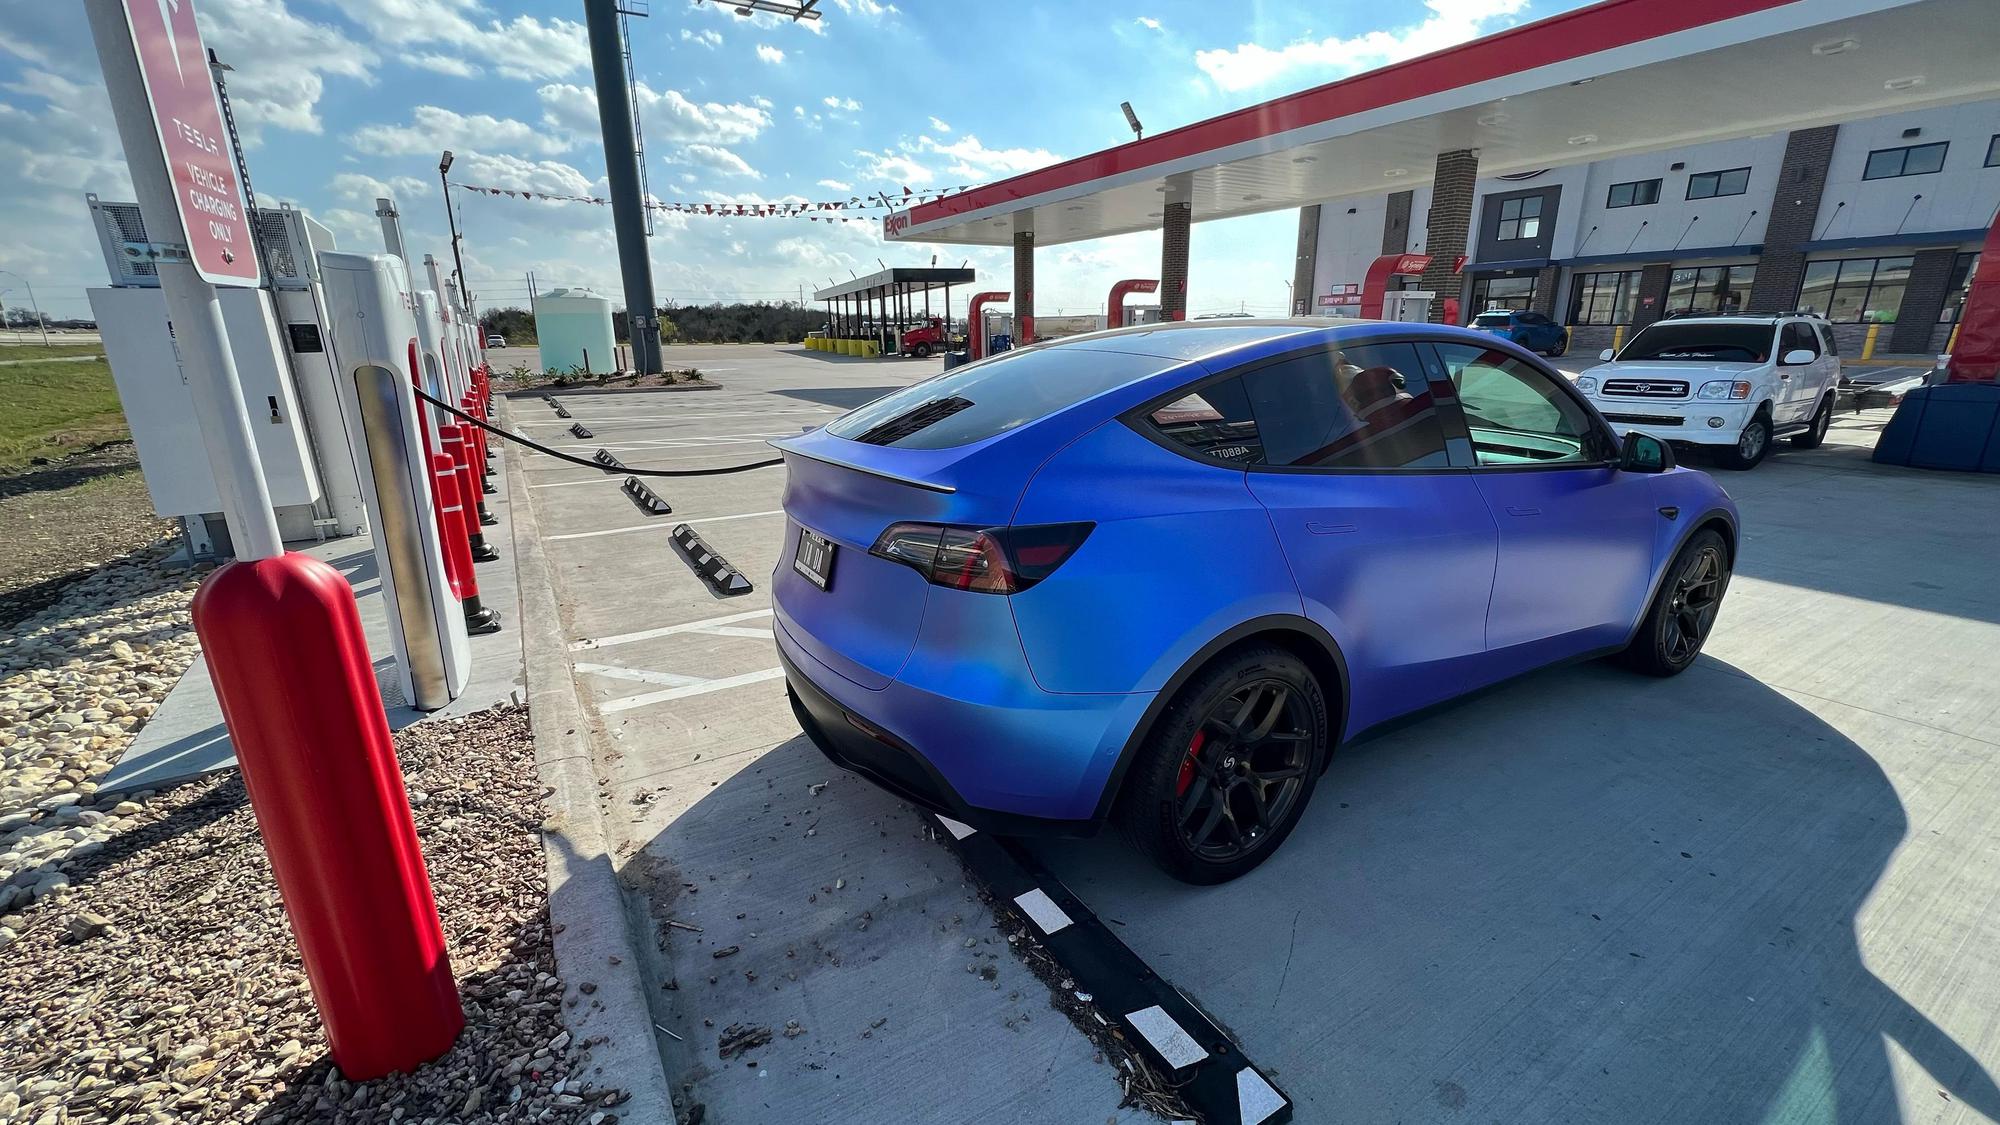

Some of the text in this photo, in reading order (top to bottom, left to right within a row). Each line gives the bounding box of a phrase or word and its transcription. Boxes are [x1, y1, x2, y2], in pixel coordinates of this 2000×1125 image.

[172, 118, 220, 156] TESLA
[186, 162, 228, 195] VEHICLE
[189, 189, 238, 221] CHARGING
[209, 221, 233, 243] ONLY
[885, 215, 908, 236] Exxon
[809, 531, 825, 546] TEXAS
